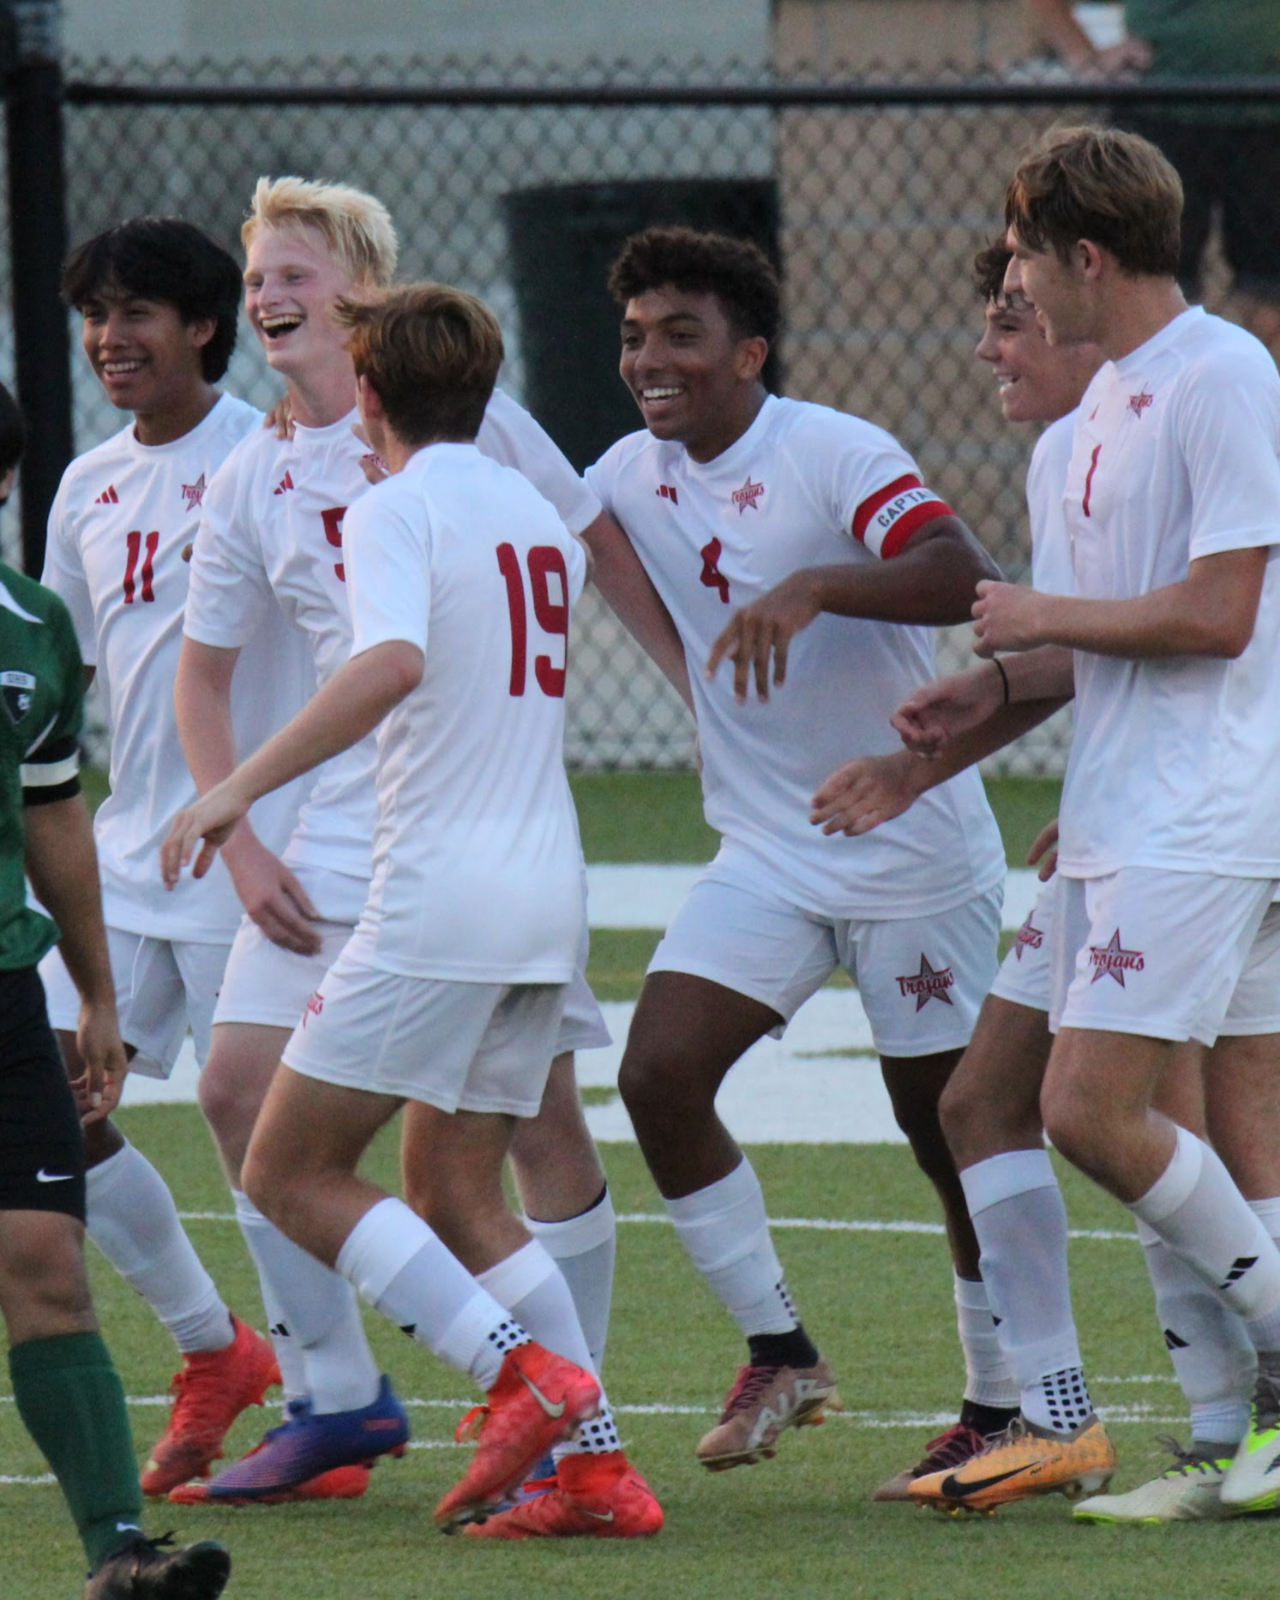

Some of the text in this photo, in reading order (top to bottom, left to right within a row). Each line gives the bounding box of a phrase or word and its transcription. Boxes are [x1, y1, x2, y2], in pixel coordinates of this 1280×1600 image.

[877, 490, 930, 528] CAPTA
[1082, 443, 1101, 517] 1
[123, 530, 159, 604] 11
[700, 536, 730, 604] 4
[496, 542, 569, 698] 19
